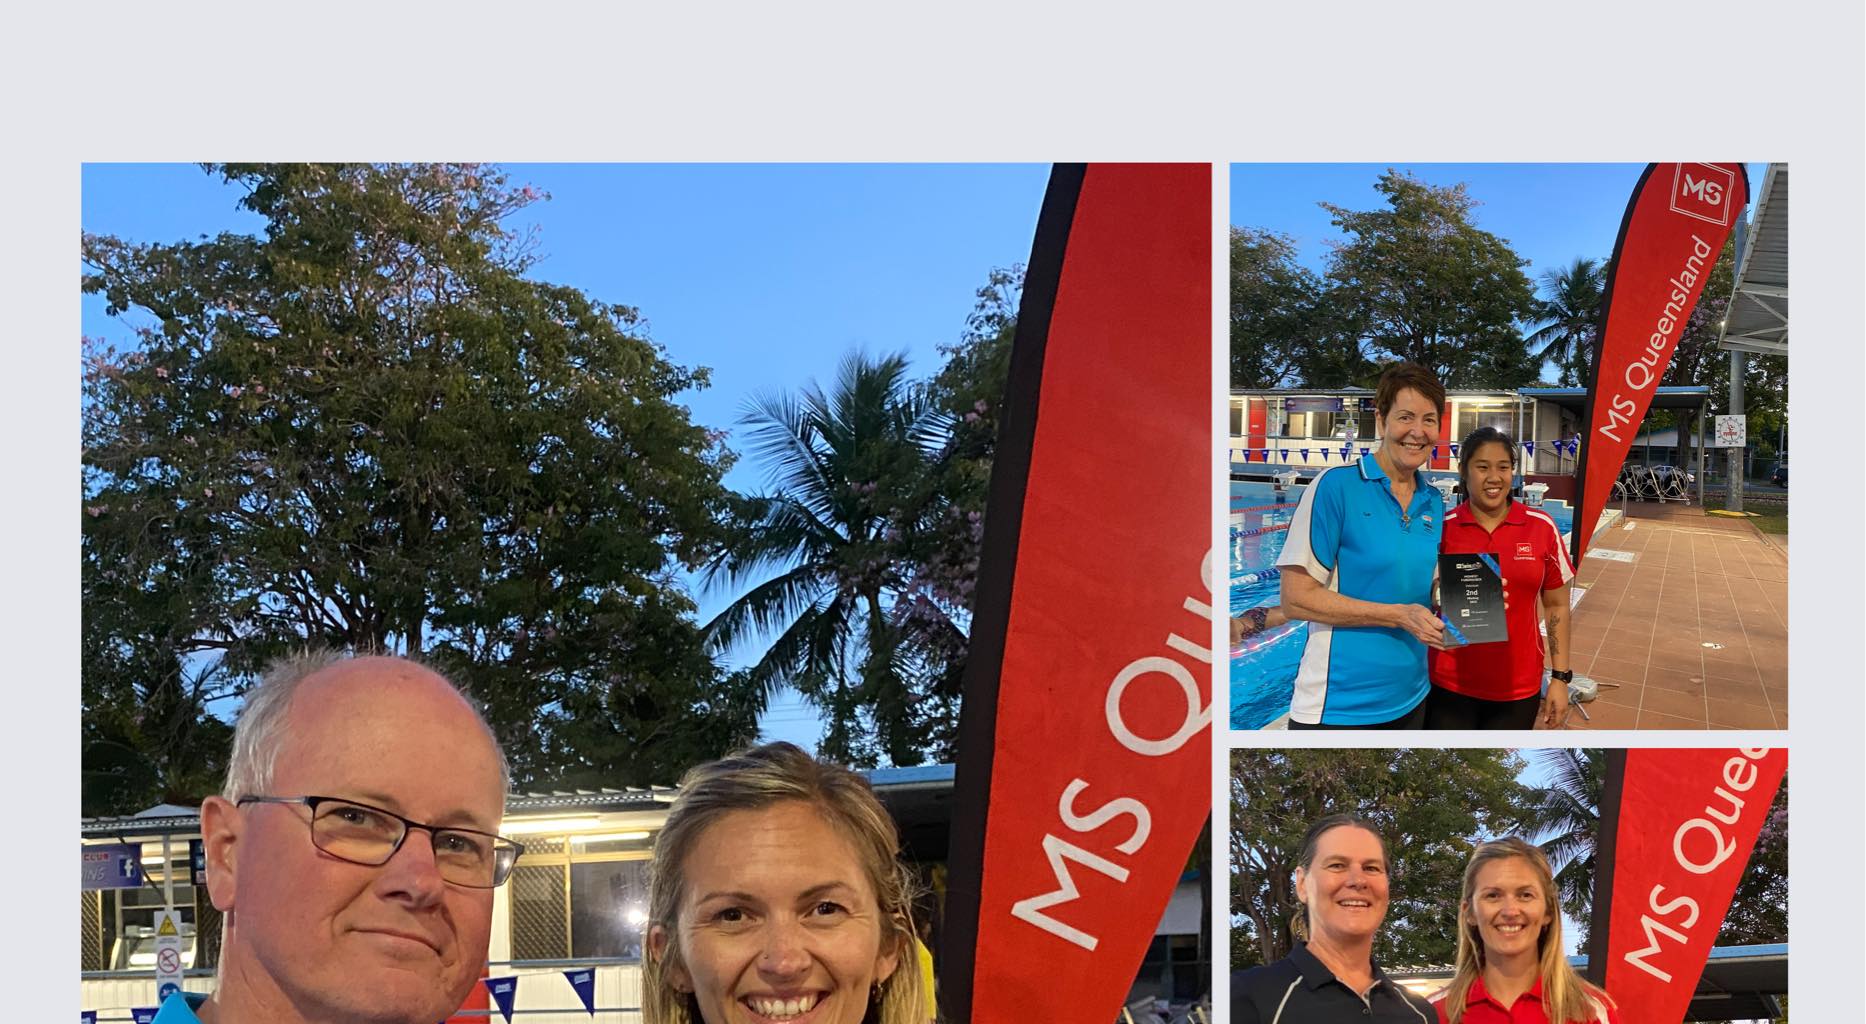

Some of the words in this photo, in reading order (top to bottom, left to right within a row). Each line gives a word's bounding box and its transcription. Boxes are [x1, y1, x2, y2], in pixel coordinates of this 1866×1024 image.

[1683, 174, 1723, 206] MS
[1599, 394, 1636, 443] MS
[1625, 235, 1711, 391] Queensland
[1011, 778, 1152, 952] MS
[1624, 884, 1700, 984] MS
